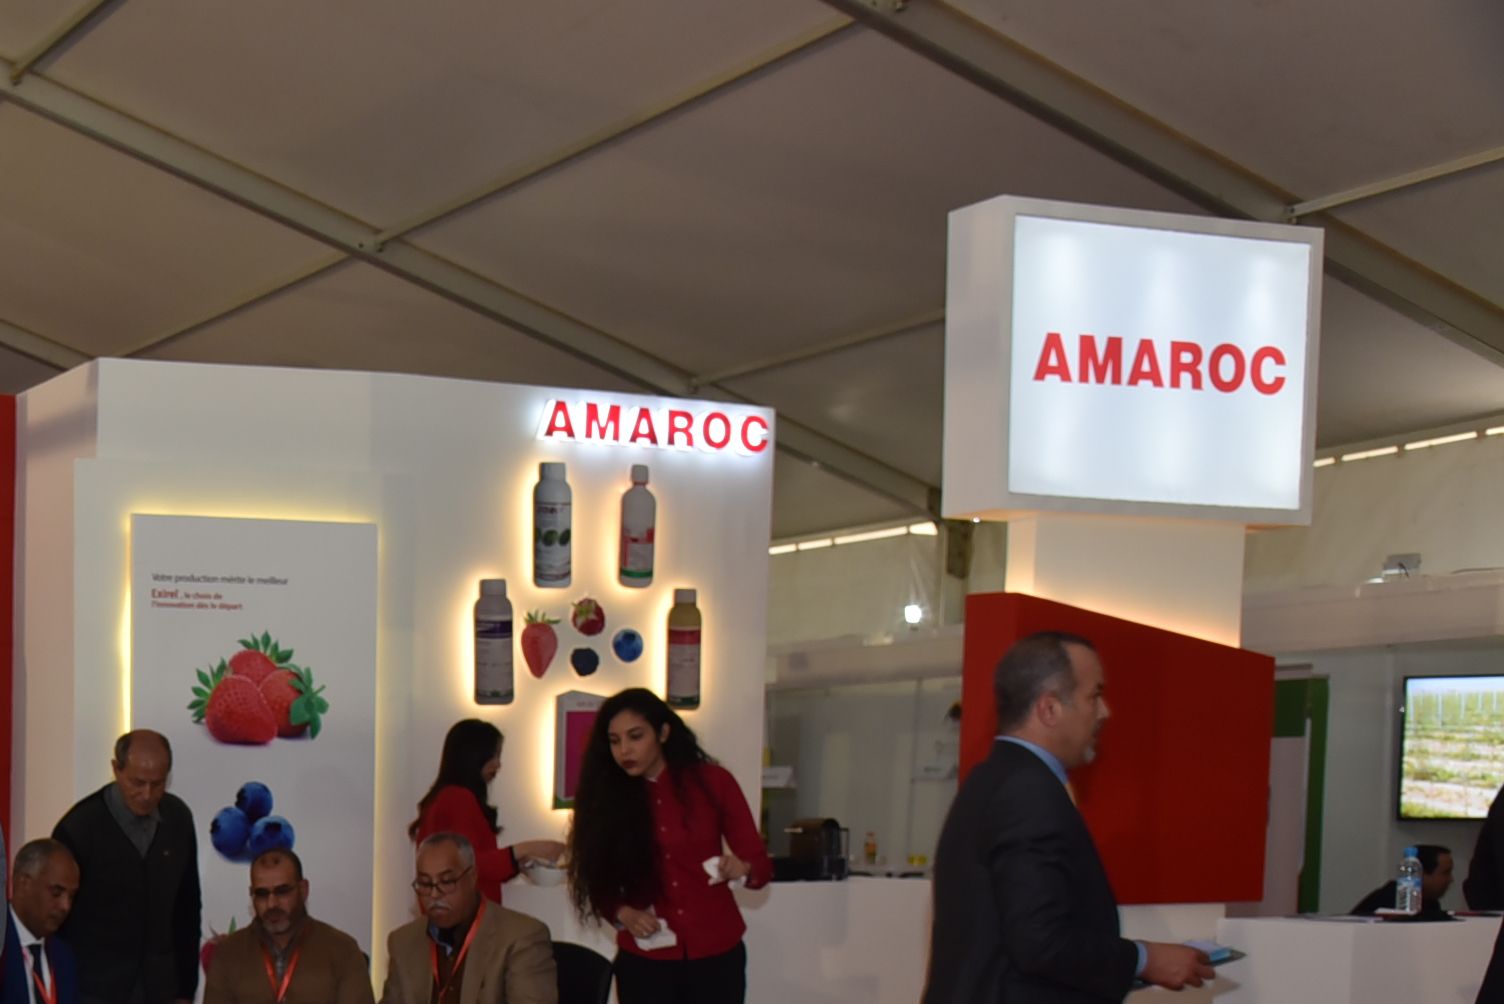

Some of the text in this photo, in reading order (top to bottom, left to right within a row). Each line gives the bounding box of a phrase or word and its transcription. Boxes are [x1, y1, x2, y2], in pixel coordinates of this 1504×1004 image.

[1033, 332, 1286, 395] AMAROC
[545, 400, 769, 453] AMAROC
[152, 573, 173, 581] Votre
[174, 573, 219, 584] production
[256, 576, 288, 585] meilleur
